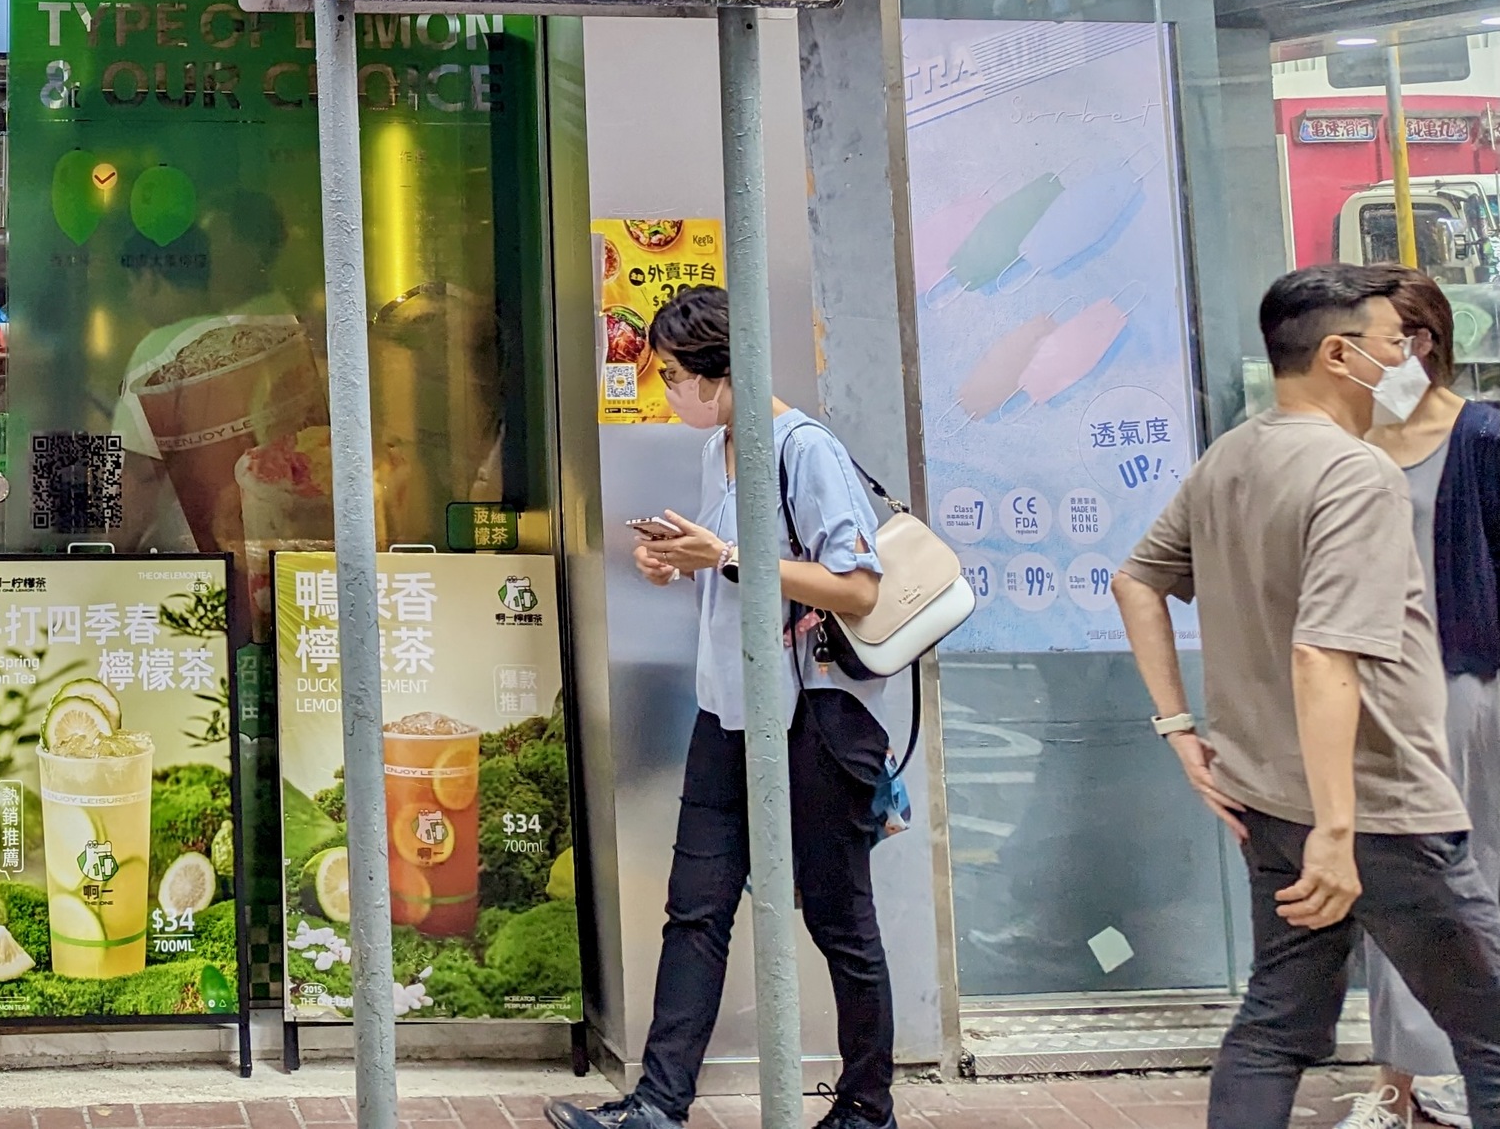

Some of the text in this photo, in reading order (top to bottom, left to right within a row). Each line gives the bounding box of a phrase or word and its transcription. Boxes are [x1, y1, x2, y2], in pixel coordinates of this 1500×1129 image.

[38, 1, 188, 49] TYPE
[293, 12, 504, 52] LMON
[39, 59, 505, 113] & OUR COICE
[1010, 95, 1160, 127] Sorbet
[692, 234, 714, 247] KeeTa
[648, 262, 717, 283] 外賣平台
[1089, 417, 1171, 449] 透氣度
[1118, 454, 1162, 489] UP!
[1070, 497, 1097, 505] 香港製造
[954, 501, 984, 530] Class 7
[1015, 517, 1038, 529] FDA
[1071, 514, 1098, 523] HONG
[1072, 523, 1099, 533] KONG
[978, 566, 989, 597] 3
[1025, 566, 1056, 597] 99%
[295, 626, 437, 674] 檸茶
[13, 672, 36, 685] Tea
[97, 648, 215, 691] 檸檬茶
[498, 668, 538, 690] 爆款
[297, 678, 429, 694] DUCK EMENT
[499, 691, 538, 713] 推薦
[80, 795, 131, 805] LEISURE
[2, 785, 19, 869] 熱銷推薦
[502, 811, 542, 836] $34
[502, 839, 544, 853] 700ml
[82, 884, 114, 900] 啊一
[151, 907, 196, 933] $34
[153, 939, 196, 953] 700ML
[303, 985, 323, 994] 2015
[300, 997, 316, 1006] THE
